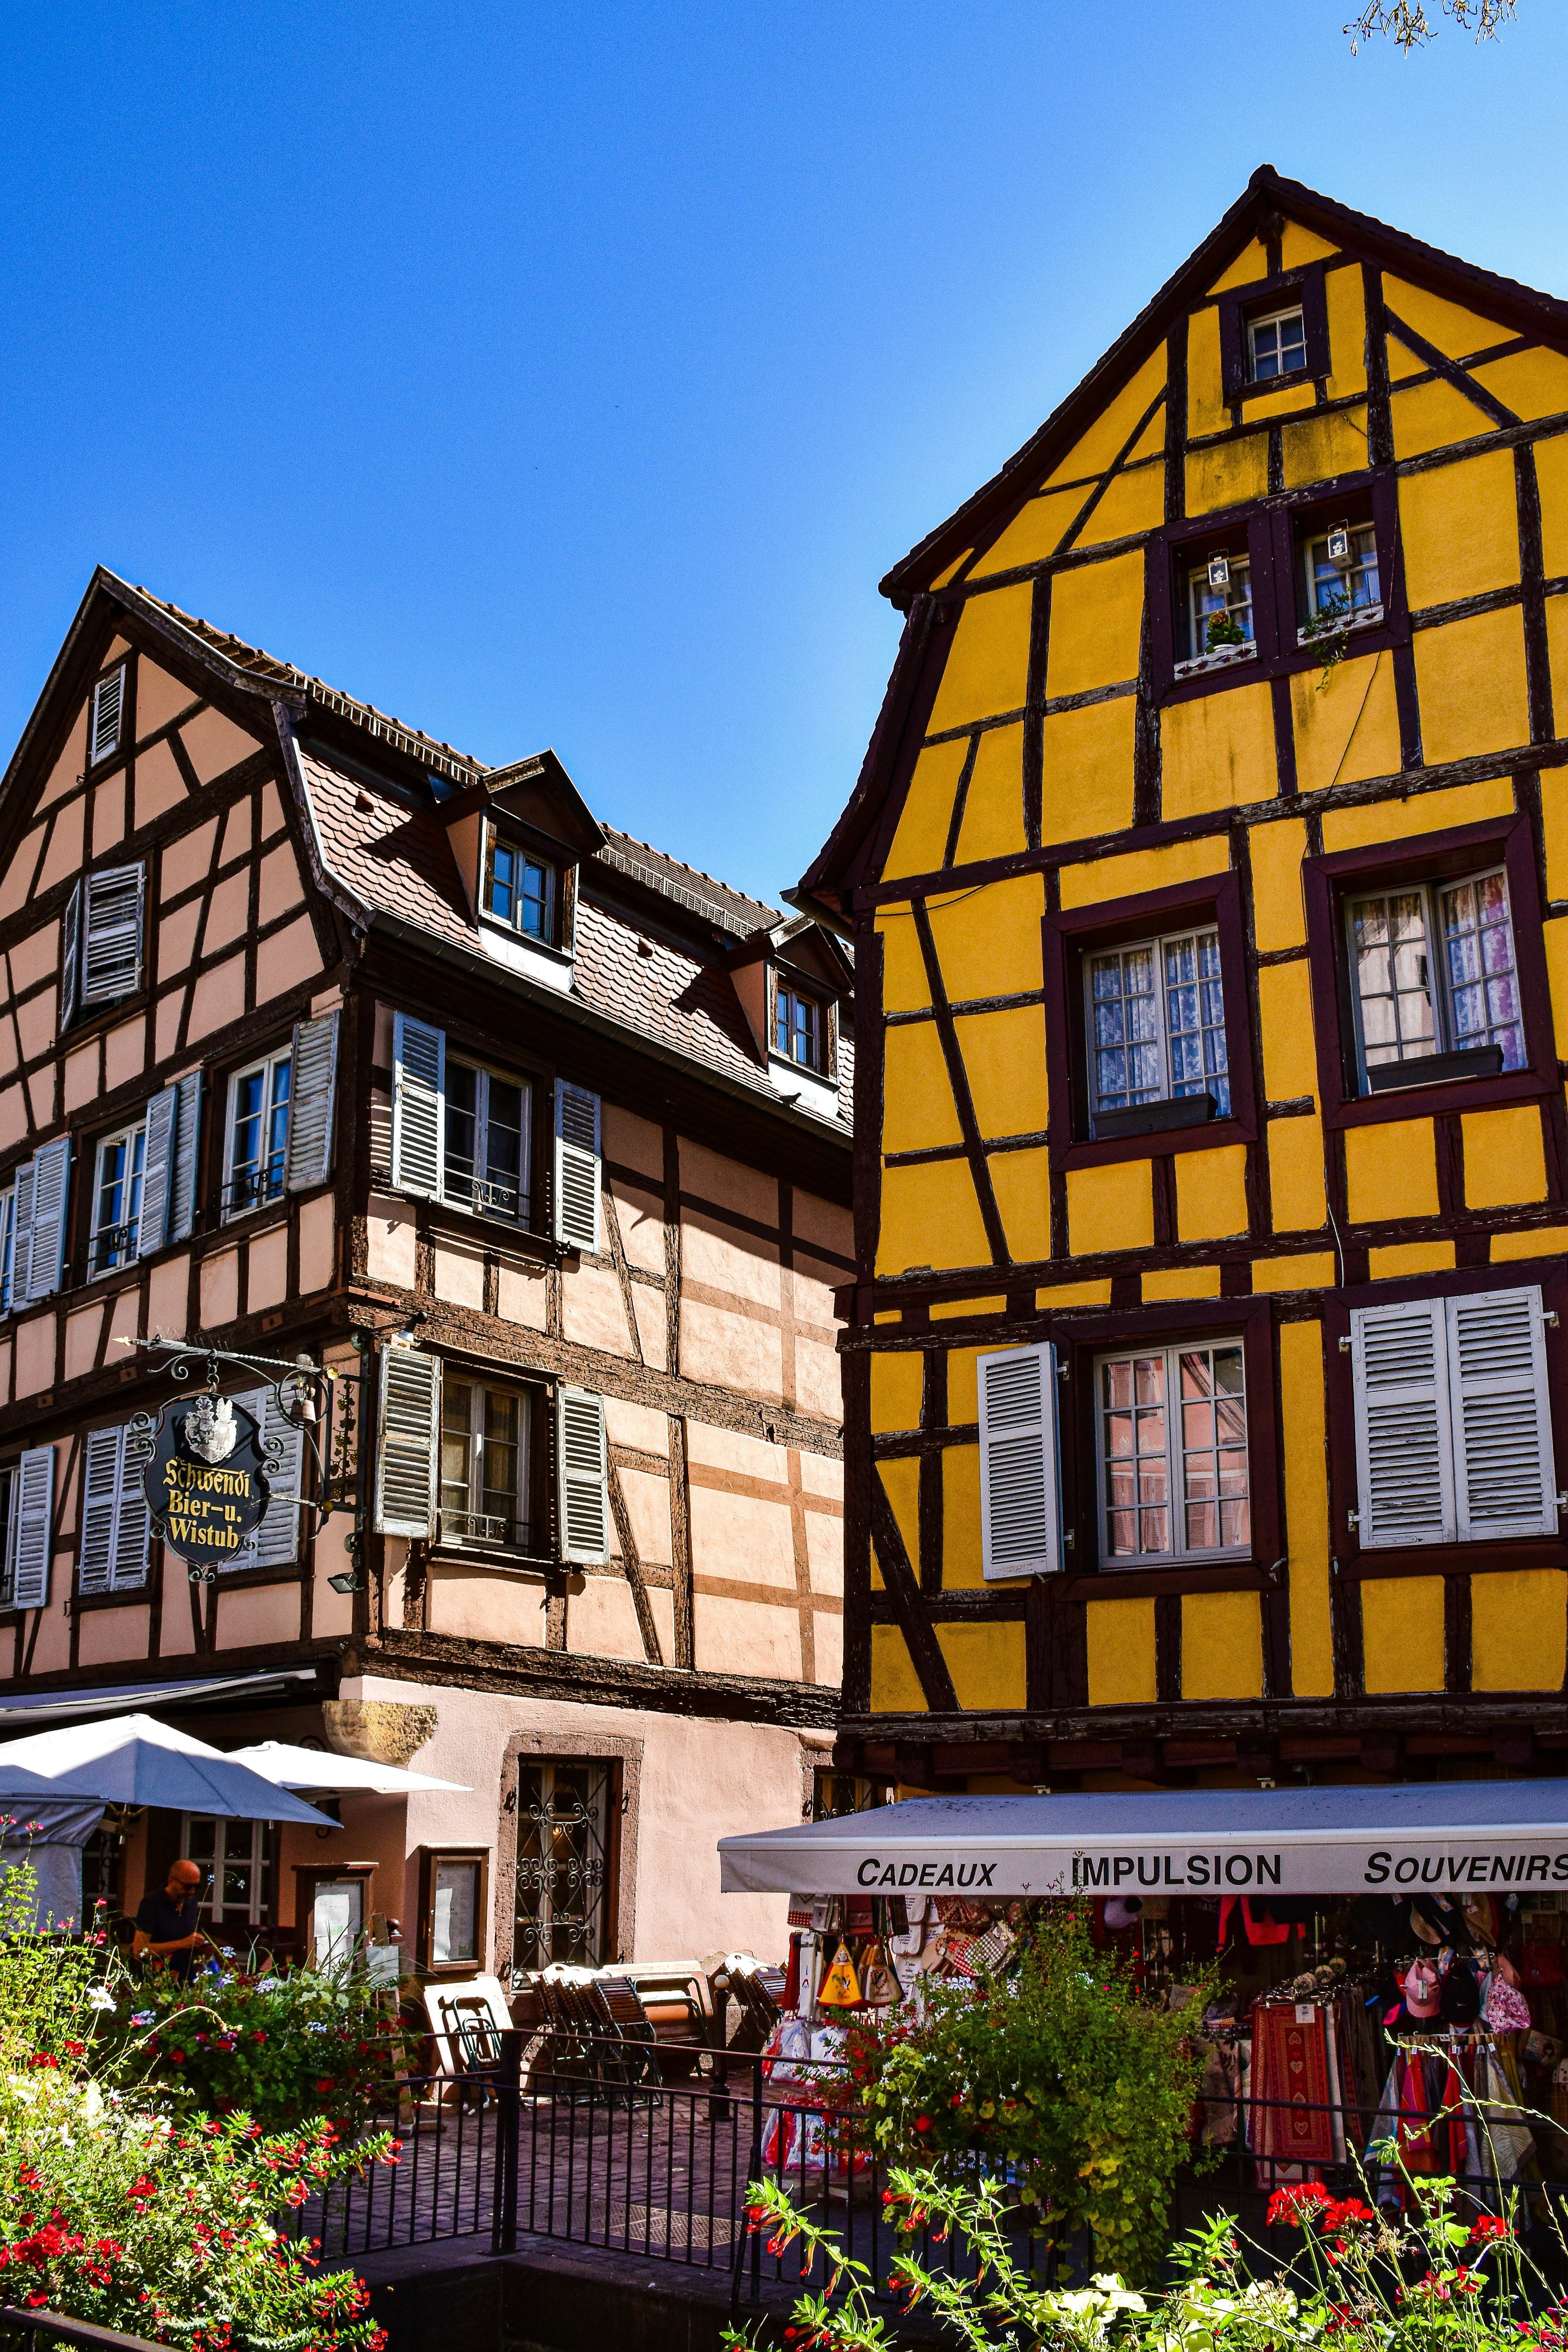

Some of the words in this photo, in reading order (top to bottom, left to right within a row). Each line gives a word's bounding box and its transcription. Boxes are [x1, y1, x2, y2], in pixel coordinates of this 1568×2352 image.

[163, 1456, 250, 1498] Schwendi
[169, 1517, 238, 1548] Wistub
[857, 1858, 998, 1887] CADEAUX
[1072, 1855, 1281, 1886] IMPULSION
[1364, 1851, 1568, 1883] SOUVENIRS
